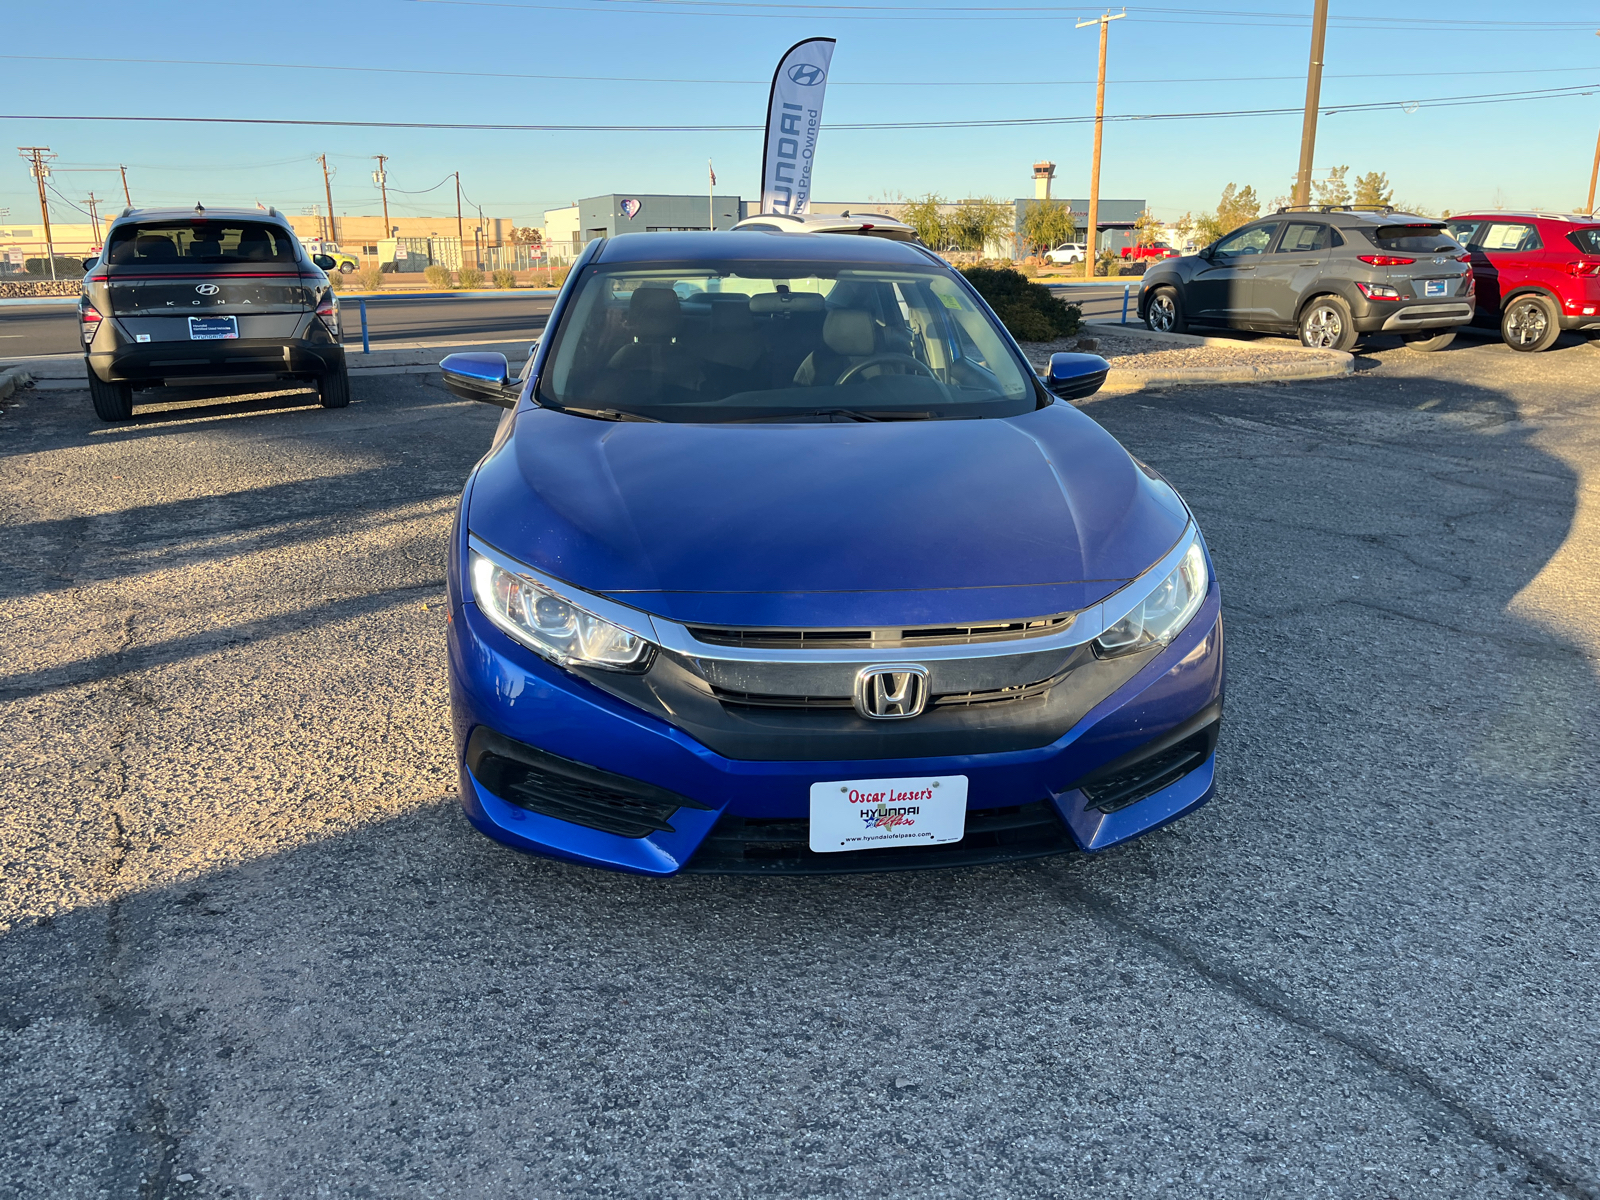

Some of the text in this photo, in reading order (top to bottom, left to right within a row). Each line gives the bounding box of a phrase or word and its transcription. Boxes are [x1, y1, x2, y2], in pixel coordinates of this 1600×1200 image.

[798, 109, 818, 188] Pre-Owned
[848, 787, 933, 803] Oscar Leeser's
[860, 806, 920, 818] HYUNDAI
[845, 832, 932, 842] www.hyundaiofelpaso.com
